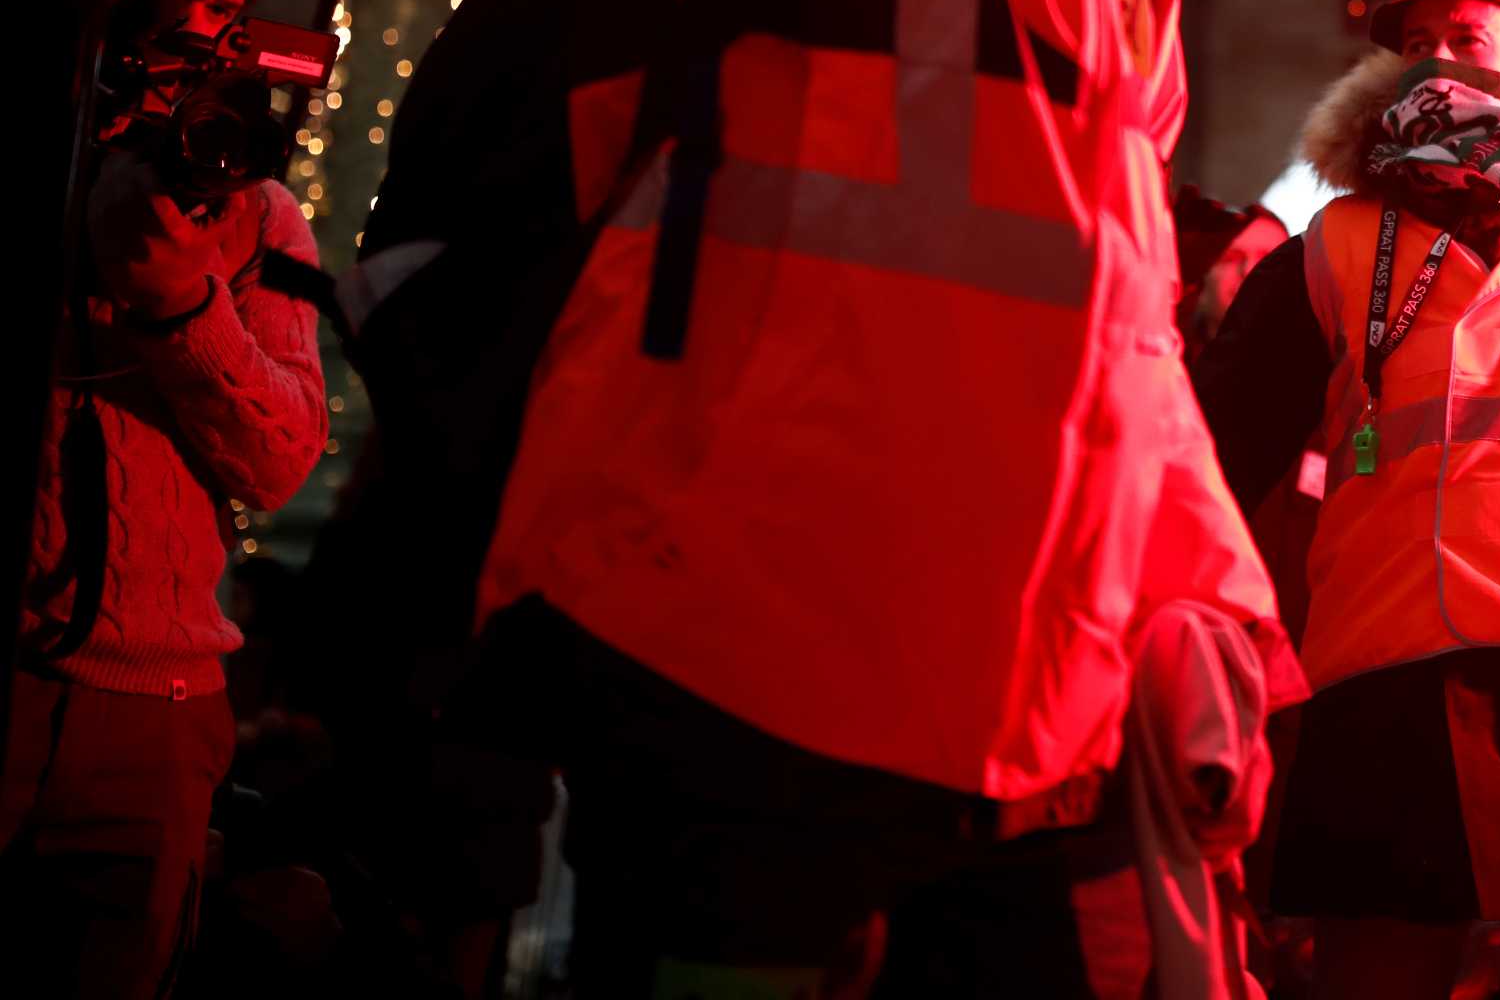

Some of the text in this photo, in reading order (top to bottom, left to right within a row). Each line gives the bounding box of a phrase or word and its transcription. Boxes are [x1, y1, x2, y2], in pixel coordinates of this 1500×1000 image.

[1371, 210, 1396, 314] GPRAT PASS 360
[1403, 283, 1427, 317] PASS
[1419, 262, 1438, 285] 360
